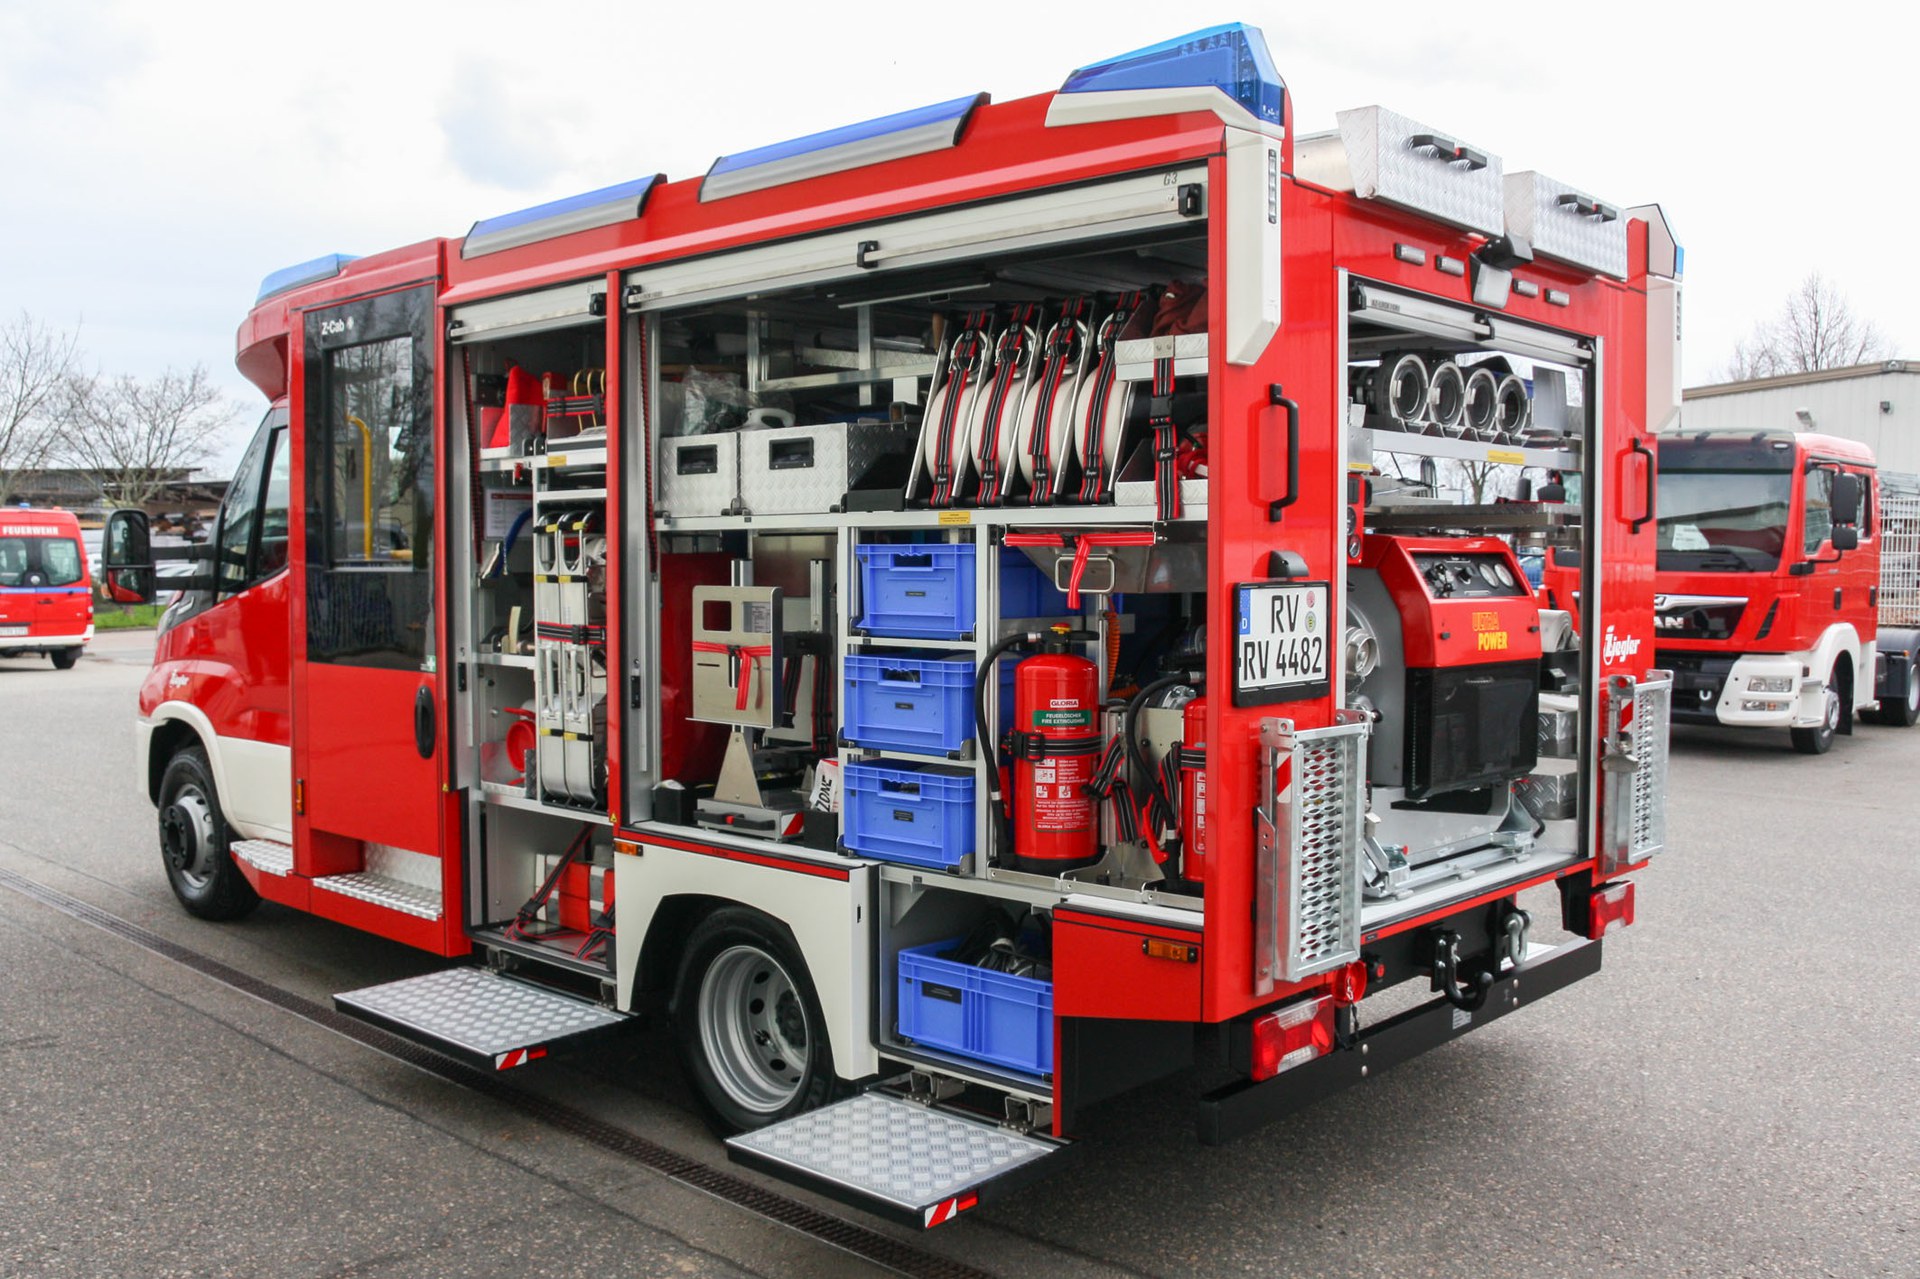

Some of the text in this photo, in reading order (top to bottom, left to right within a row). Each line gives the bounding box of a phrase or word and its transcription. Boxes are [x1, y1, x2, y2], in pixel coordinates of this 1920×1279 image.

[1163, 171, 1178, 186] G3
[321, 319, 345, 335] Z-Cab
[1062, 317, 1070, 327] B
[965, 330, 973, 340] B
[2, 526, 59, 535] FEUERWEHR
[1271, 594, 1299, 634] RV
[1472, 612, 1499, 631] ULTRA
[1241, 618, 1248, 630] D
[1653, 616, 1683, 628] AN
[1478, 632, 1507, 650] POWER
[1243, 636, 1322, 681] RV 4482
[815, 774, 832, 812] ZONE
